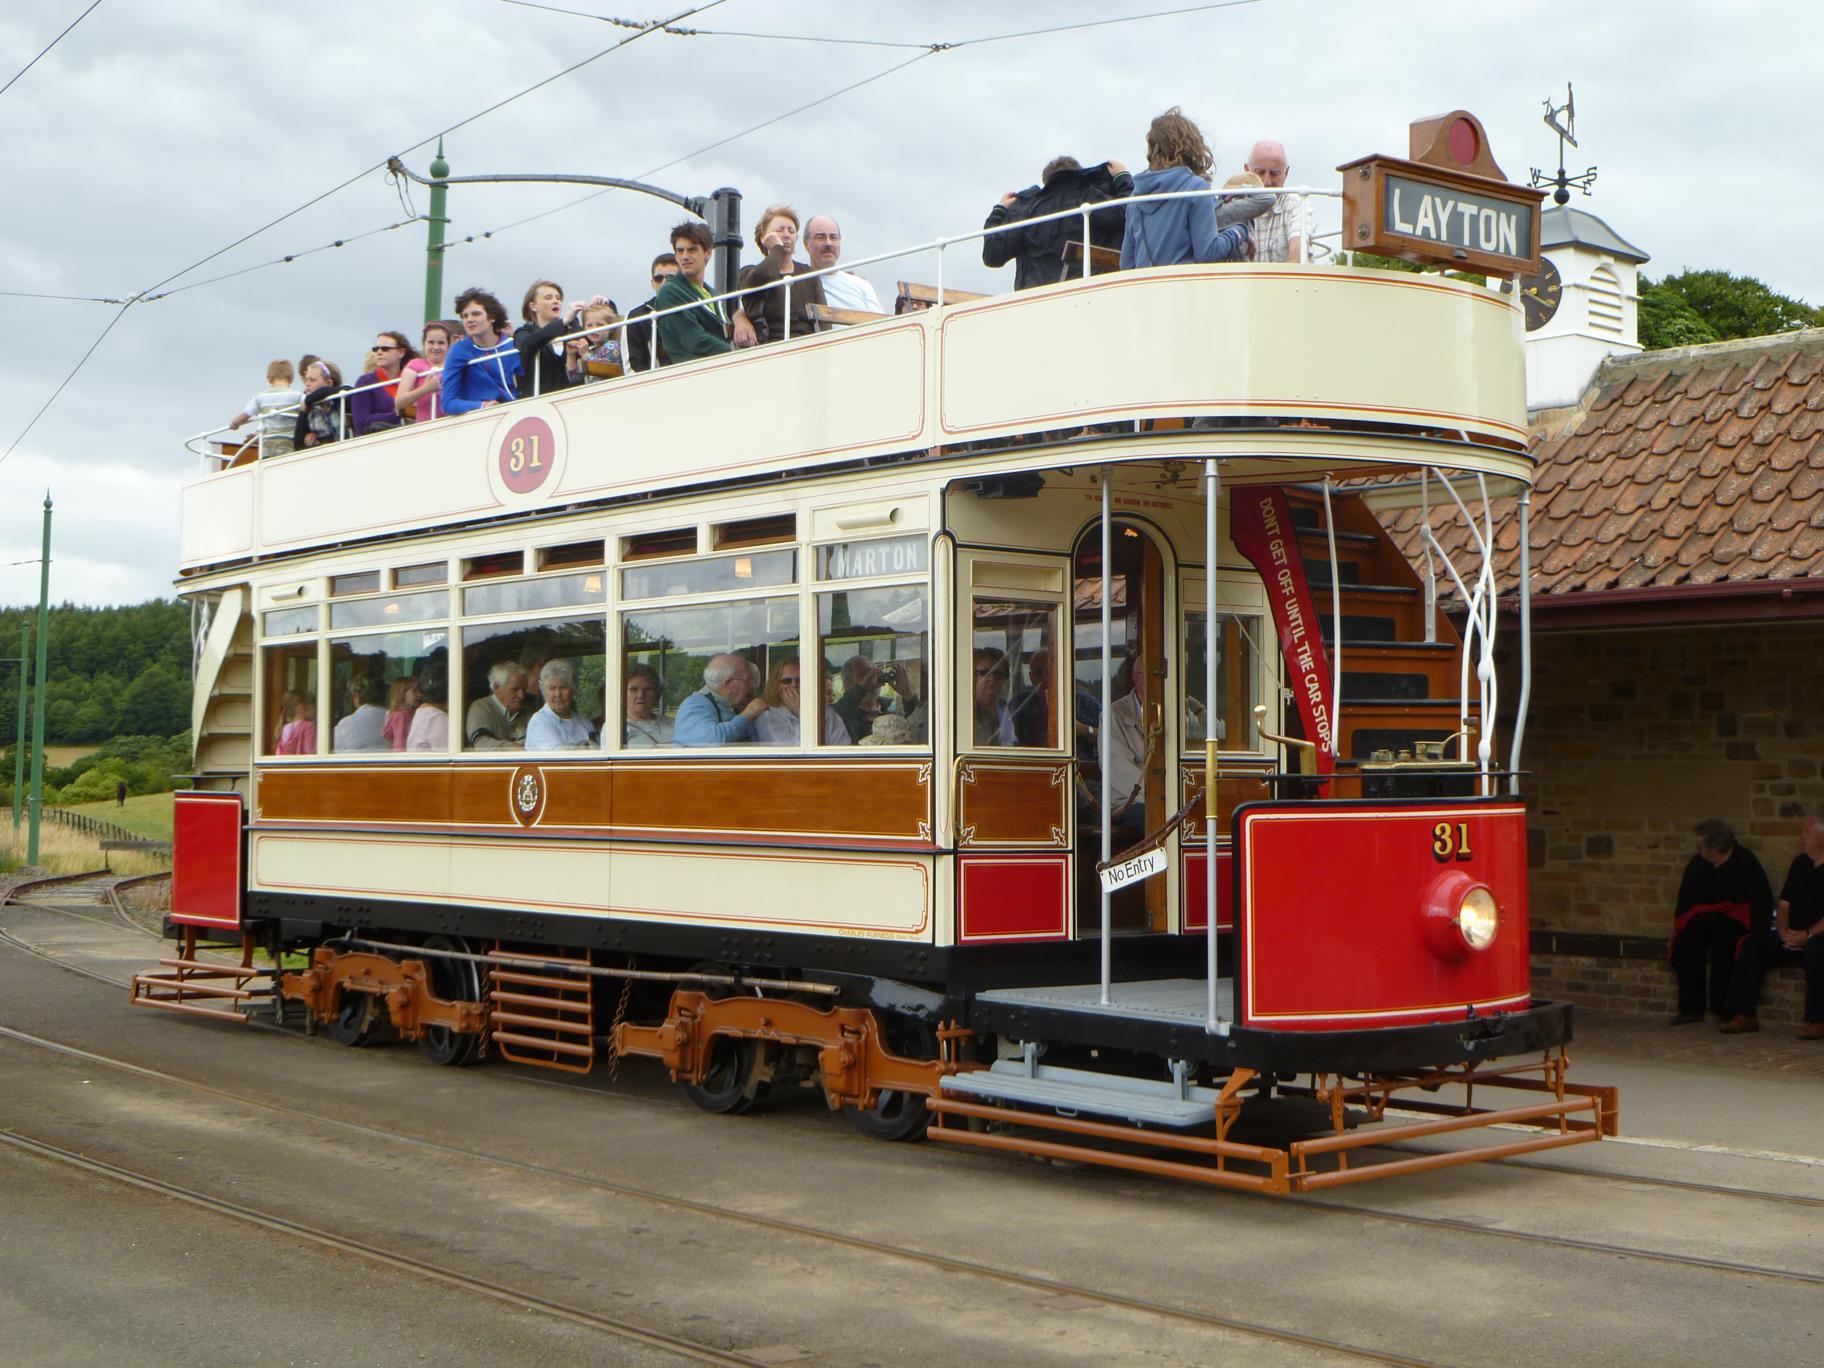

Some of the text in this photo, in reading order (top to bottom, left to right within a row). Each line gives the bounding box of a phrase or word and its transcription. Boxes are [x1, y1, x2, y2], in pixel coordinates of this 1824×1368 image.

[1393, 187, 1517, 256] LAYTON
[509, 434, 543, 475] 31
[837, 542, 918, 577] MARTON
[1270, 538, 1288, 566] GET
[1278, 568, 1295, 596] OFF
[1285, 597, 1306, 643] UNTIL
[1296, 641, 1315, 673] THE
[1304, 673, 1322, 705] CAR
[1312, 704, 1332, 753] STOPS
[1432, 822, 1472, 862] 31
[1108, 857, 1154, 885] No Entry
